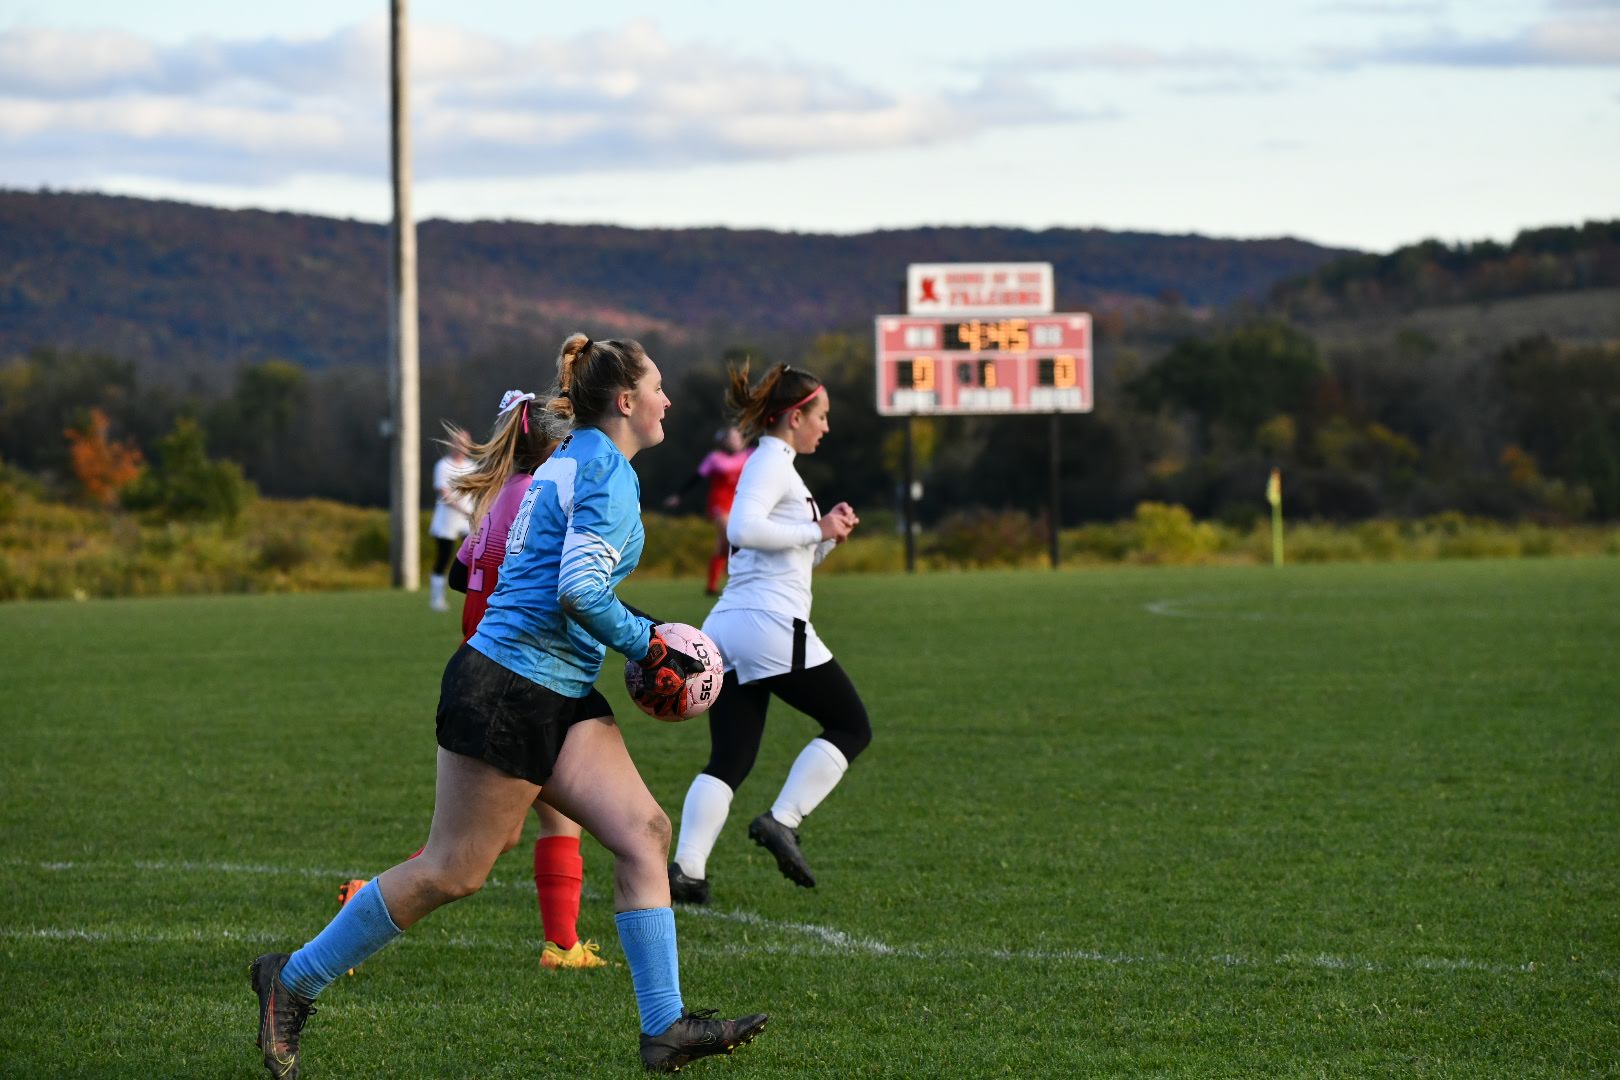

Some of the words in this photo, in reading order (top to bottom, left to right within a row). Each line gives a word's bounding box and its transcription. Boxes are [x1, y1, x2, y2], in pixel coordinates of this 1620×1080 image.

[958, 319, 1029, 353] 4:45
[984, 362, 996, 389] 1
[1054, 354, 1077, 389] 0
